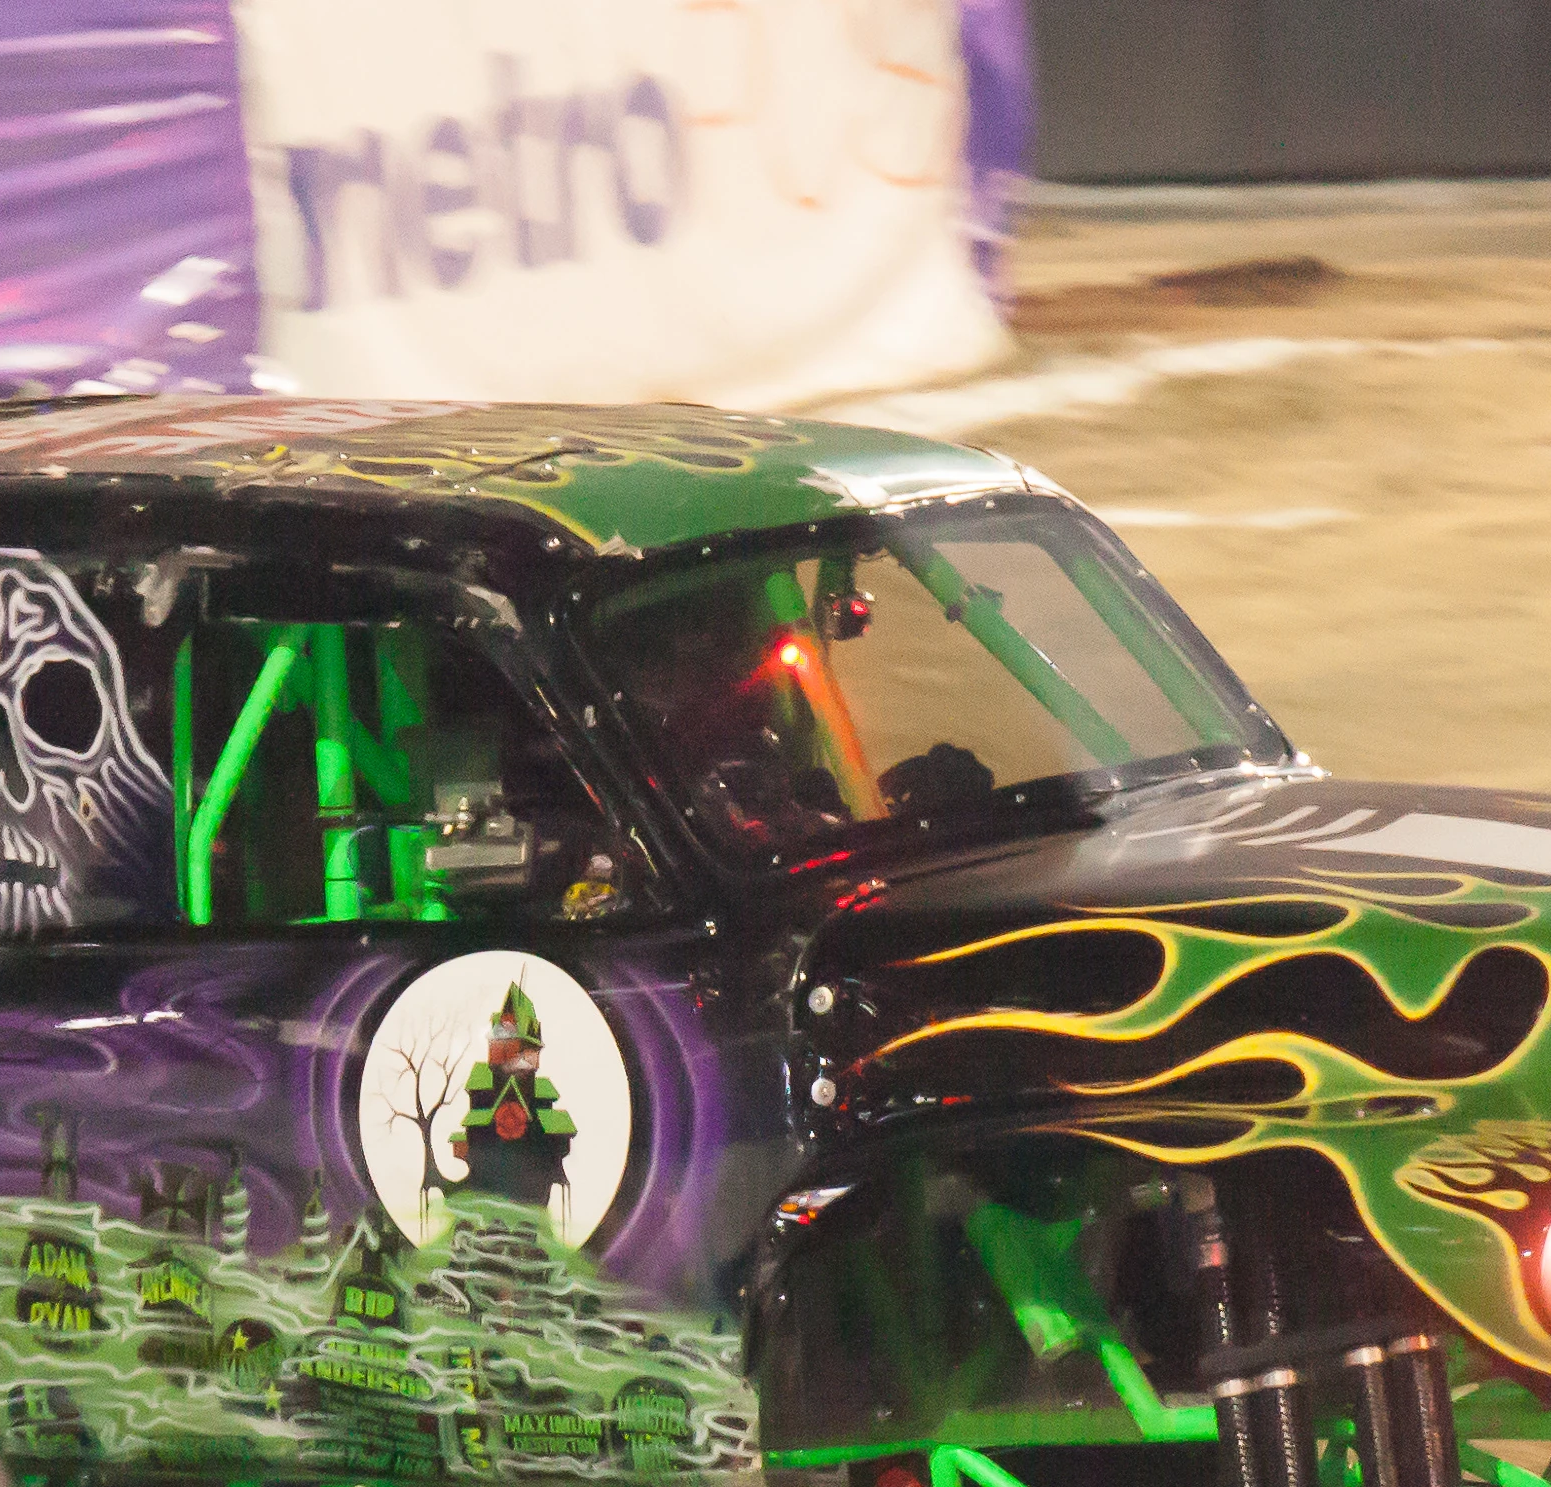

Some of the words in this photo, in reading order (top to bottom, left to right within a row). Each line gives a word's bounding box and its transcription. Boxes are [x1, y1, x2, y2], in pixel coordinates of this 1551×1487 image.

[27, 1242, 92, 1293] ADAM
[344, 1286, 395, 1319] RIP
[503, 1414, 603, 1436] MAXIMUM
